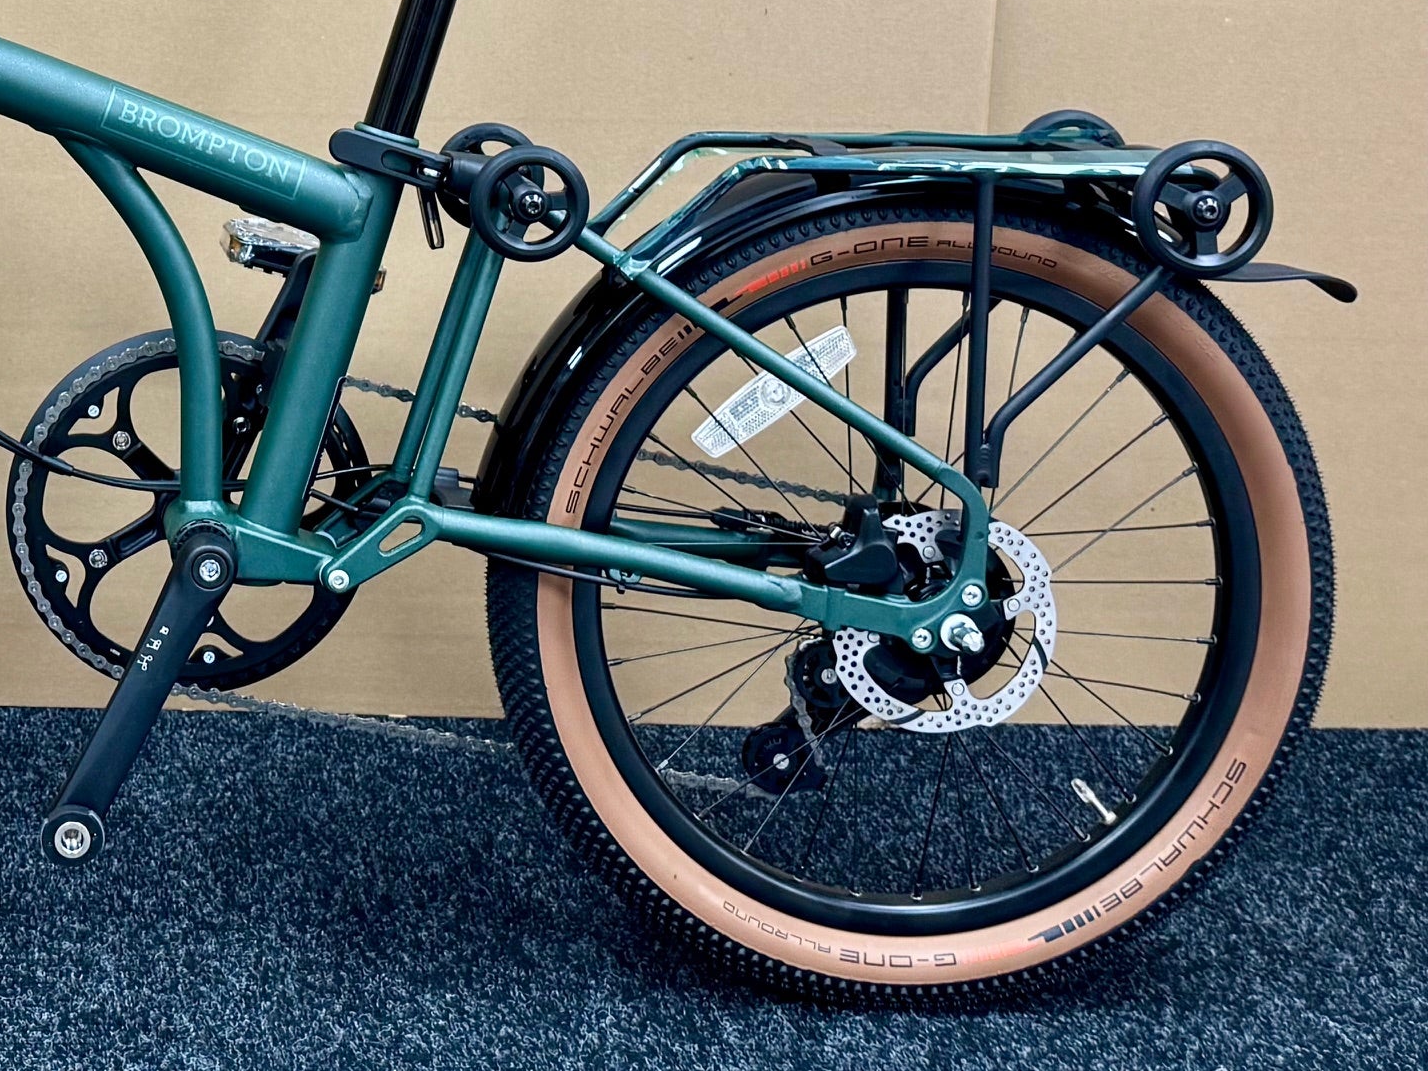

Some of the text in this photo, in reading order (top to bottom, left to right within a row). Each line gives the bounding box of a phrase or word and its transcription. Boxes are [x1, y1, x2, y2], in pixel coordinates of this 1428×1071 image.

[118, 99, 291, 183] BROMPTON
[810, 235, 930, 266] G-ONE
[565, 336, 679, 514] SCHWALBE
[1099, 758, 1247, 913] SCHWALBE
[722, 900, 957, 968] G-ONE ALLROUND
